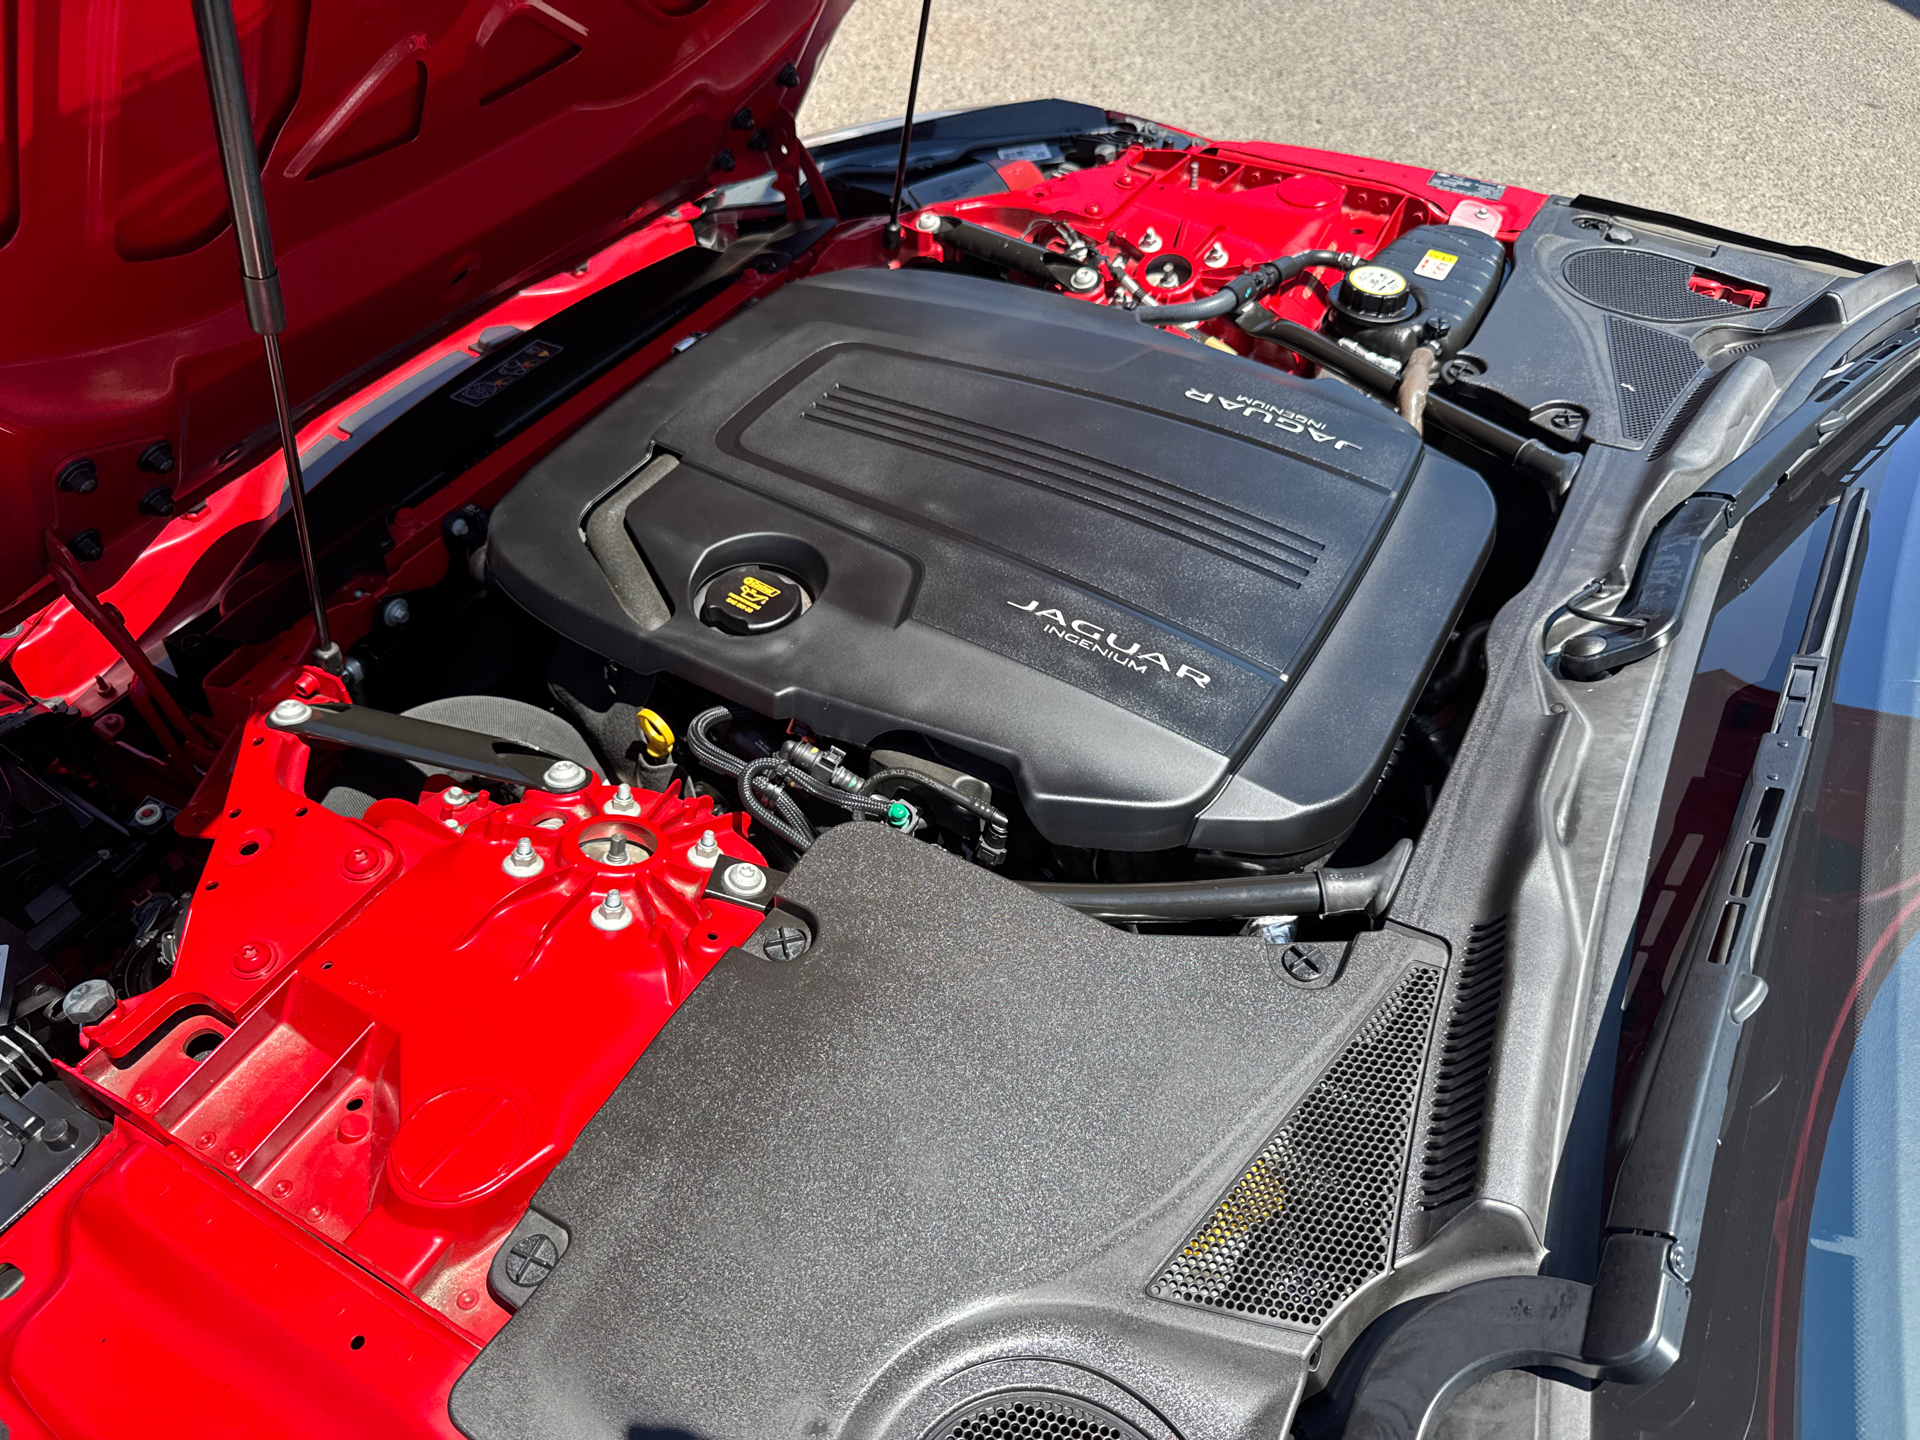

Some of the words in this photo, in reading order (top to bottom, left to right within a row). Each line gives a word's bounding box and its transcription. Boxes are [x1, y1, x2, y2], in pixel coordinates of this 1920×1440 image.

[1184, 387, 1363, 450] JAGUAR
[1236, 394, 1327, 431] INGENIUM
[1007, 600, 1211, 689] JAGUAR
[1043, 624, 1148, 674] INGENIUM
